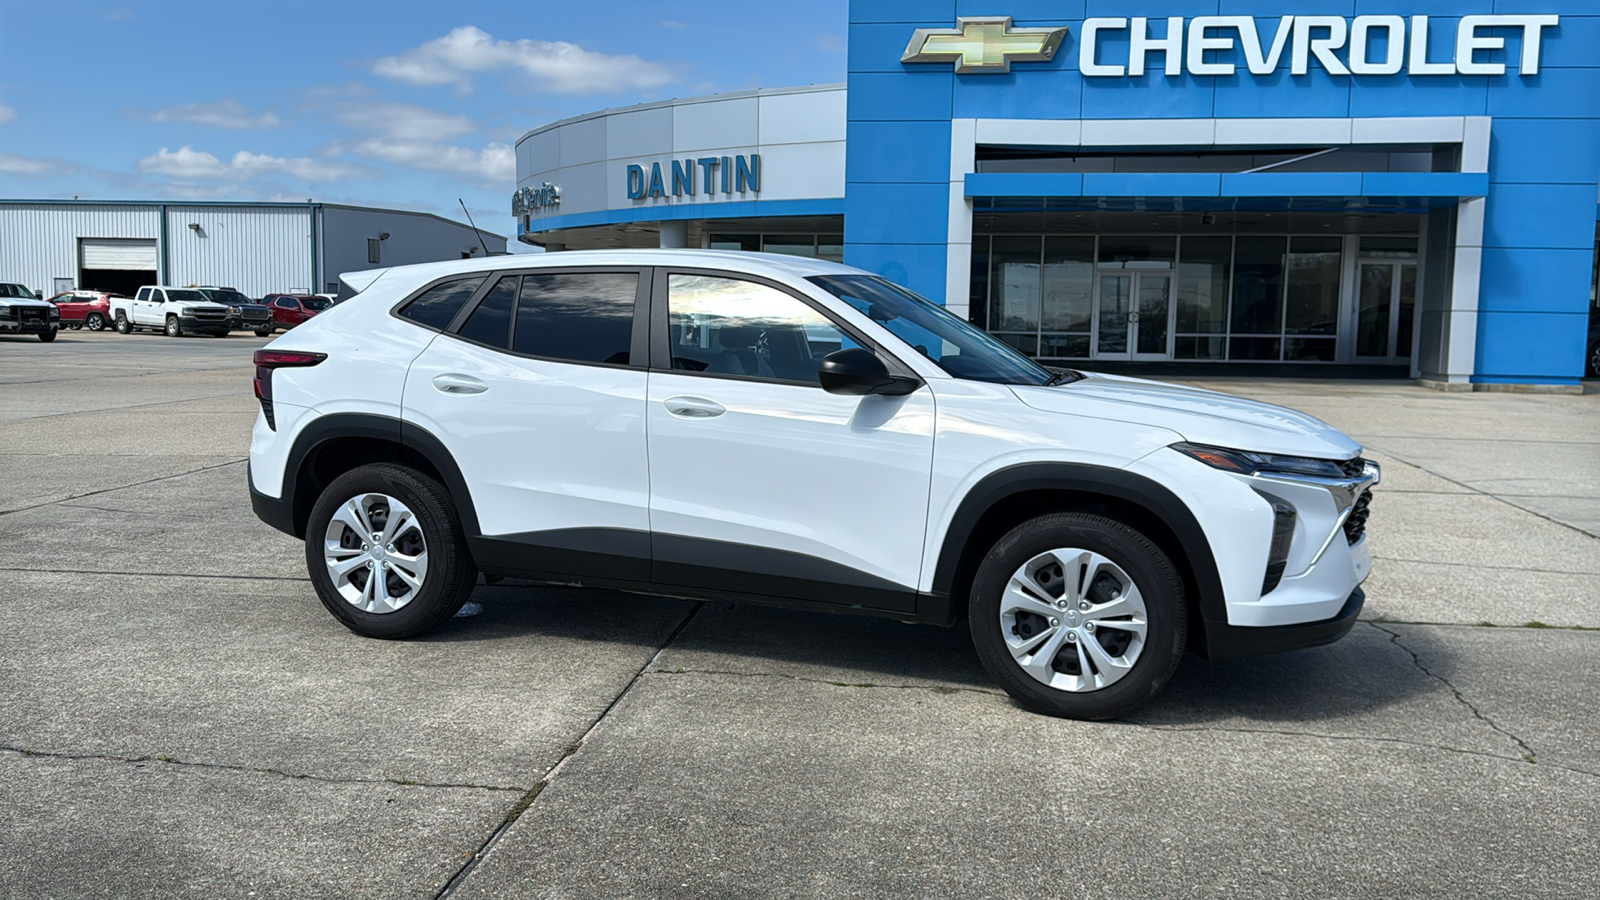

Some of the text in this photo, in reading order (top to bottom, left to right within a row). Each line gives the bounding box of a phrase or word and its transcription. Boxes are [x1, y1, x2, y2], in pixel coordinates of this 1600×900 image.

[1079, 15, 1559, 76] CHEVROLET
[524, 181, 560, 210] Service
[627, 153, 761, 200] DANTIN
